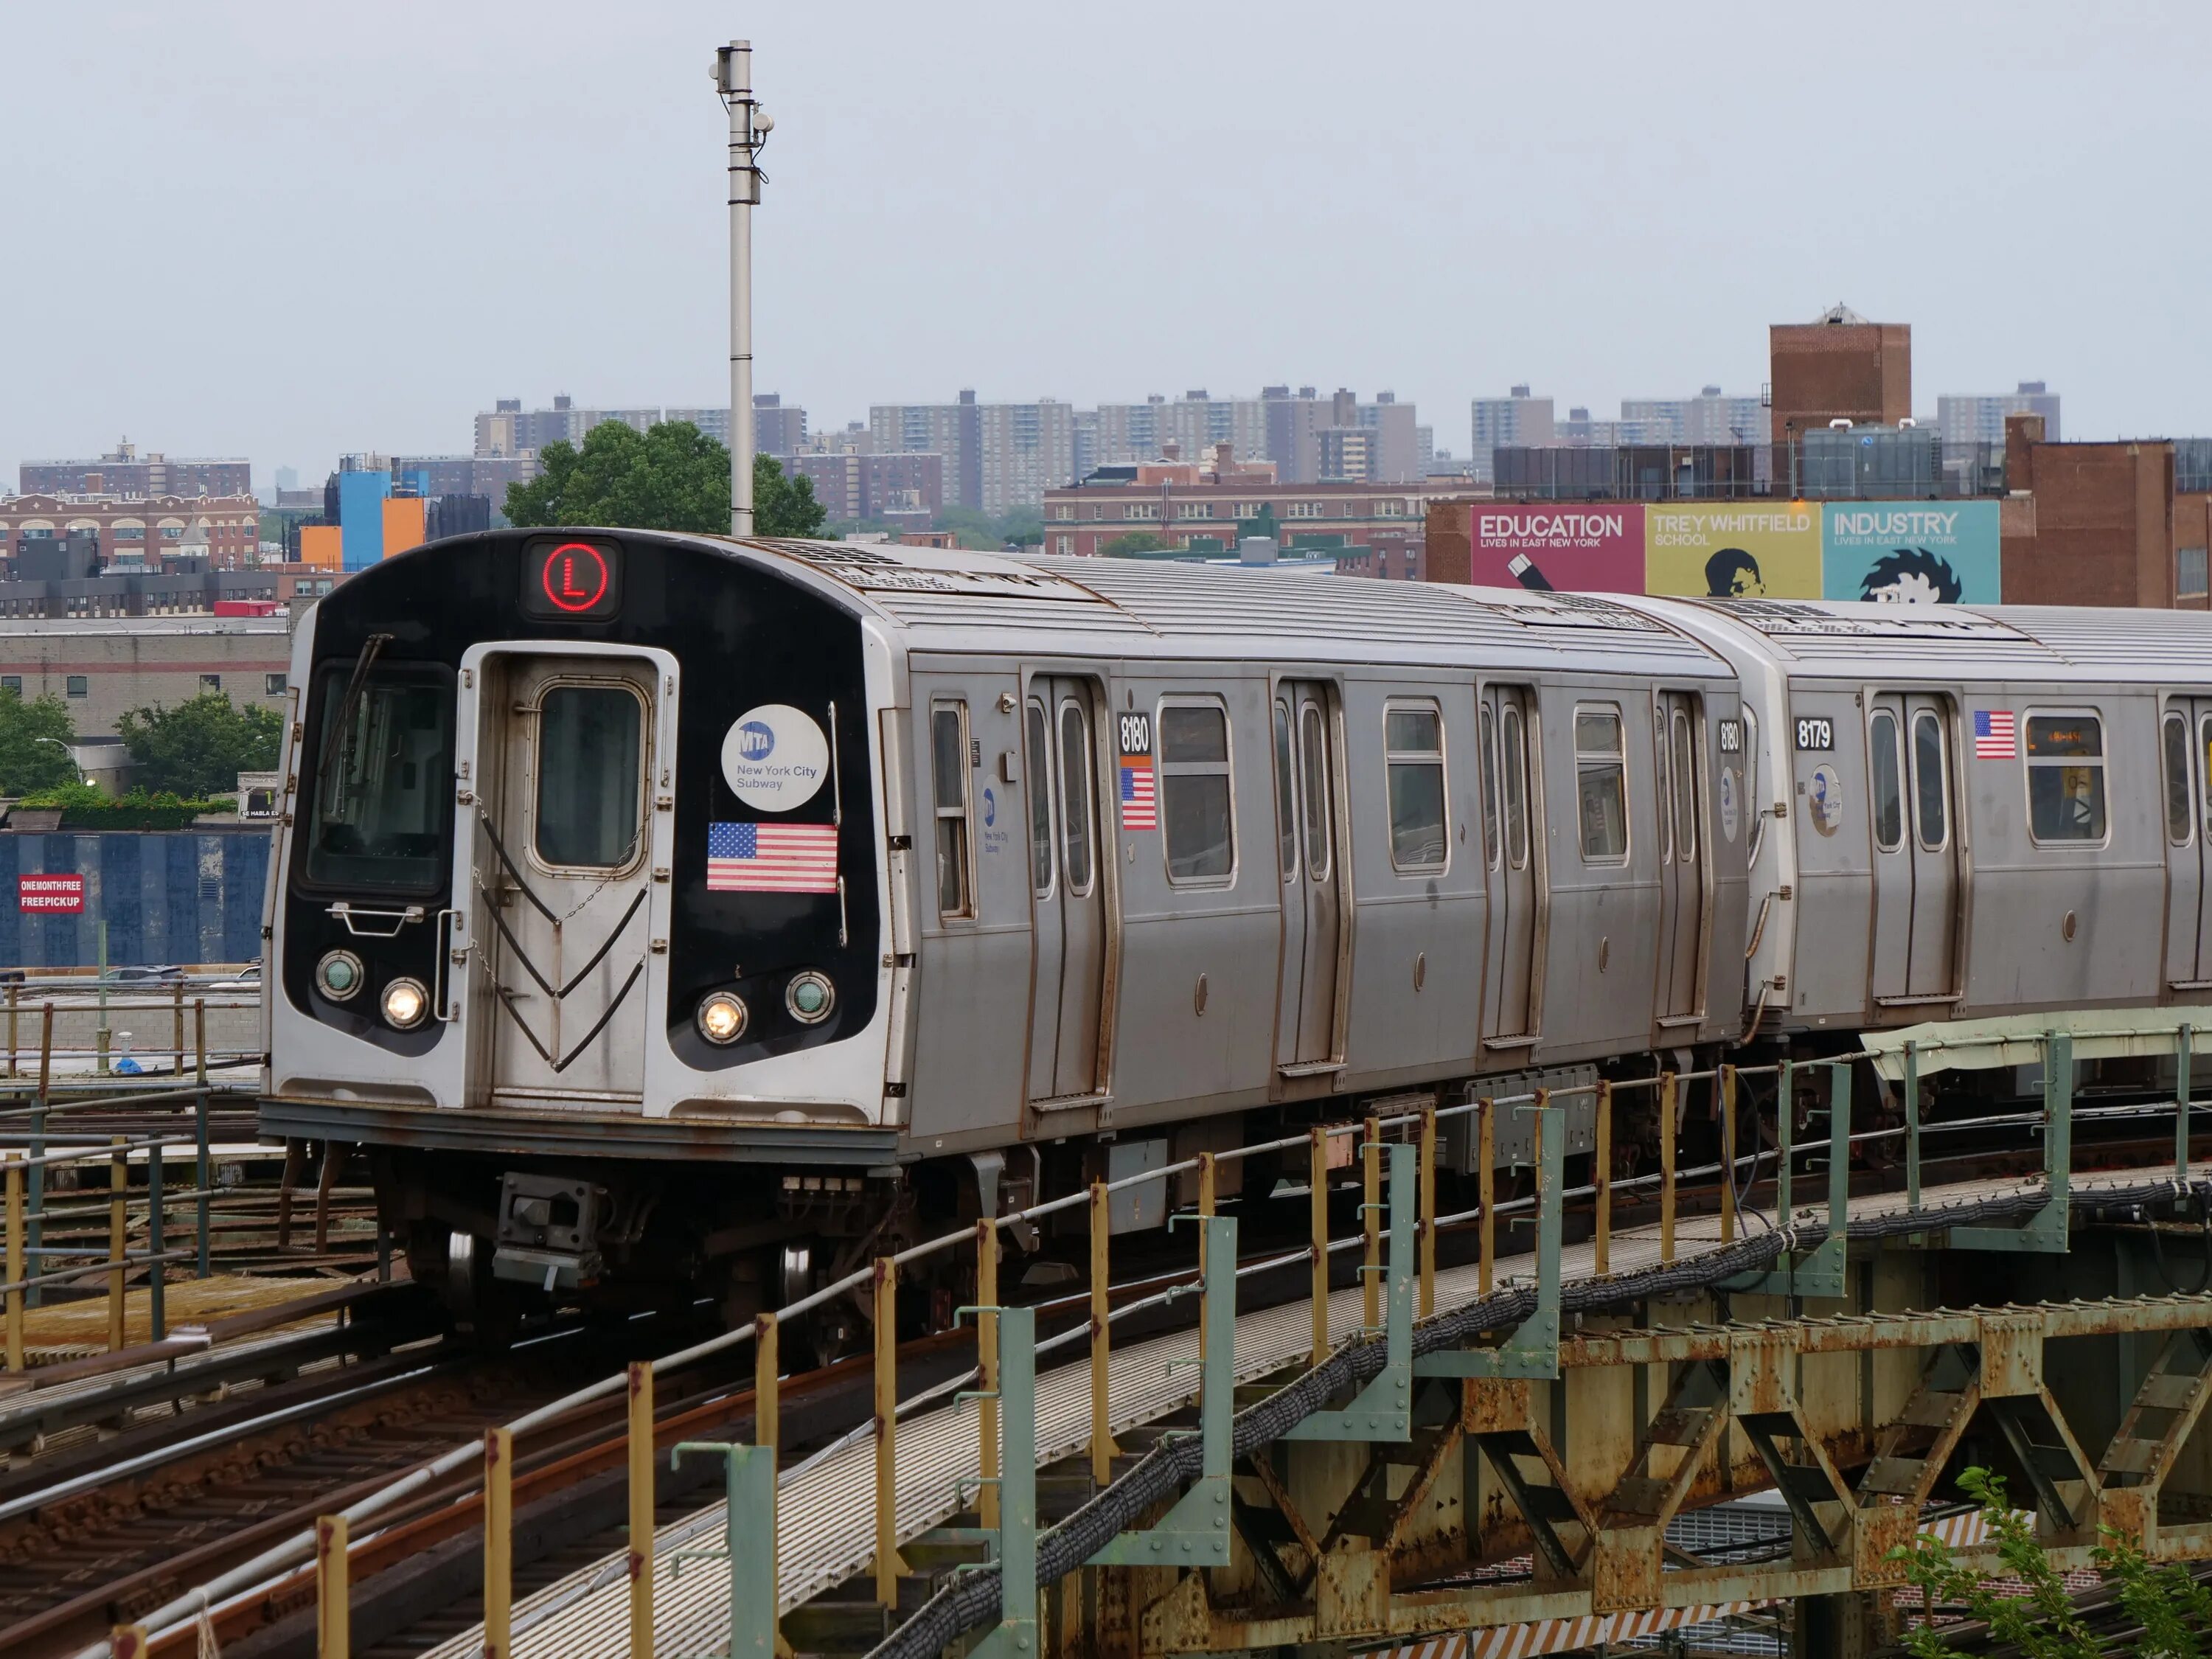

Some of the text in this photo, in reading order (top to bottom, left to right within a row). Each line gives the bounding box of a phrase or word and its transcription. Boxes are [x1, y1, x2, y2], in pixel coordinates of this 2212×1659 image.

[1480, 515, 1623, 538] EDUCATION
[1653, 514, 1810, 532] TREY WHITFIELD
[1834, 512, 1959, 535] INDUSTRY
[1481, 538, 1601, 548] LIVES IN EAST NEW YORK
[1655, 533, 1711, 546] SCHOOL
[1834, 535, 1958, 546] LIVES IN EAST NEW YORK
[563, 557, 585, 596] L
[738, 730, 769, 753] MTA
[1121, 716, 1149, 752] 8180
[1721, 722, 1739, 751] 8180
[1798, 720, 1831, 748] 8179
[737, 765, 817, 779] New York City
[737, 778, 783, 791] Subway
[21, 881, 81, 891] ONE MONTH FREE
[21, 897, 44, 907] FREE
